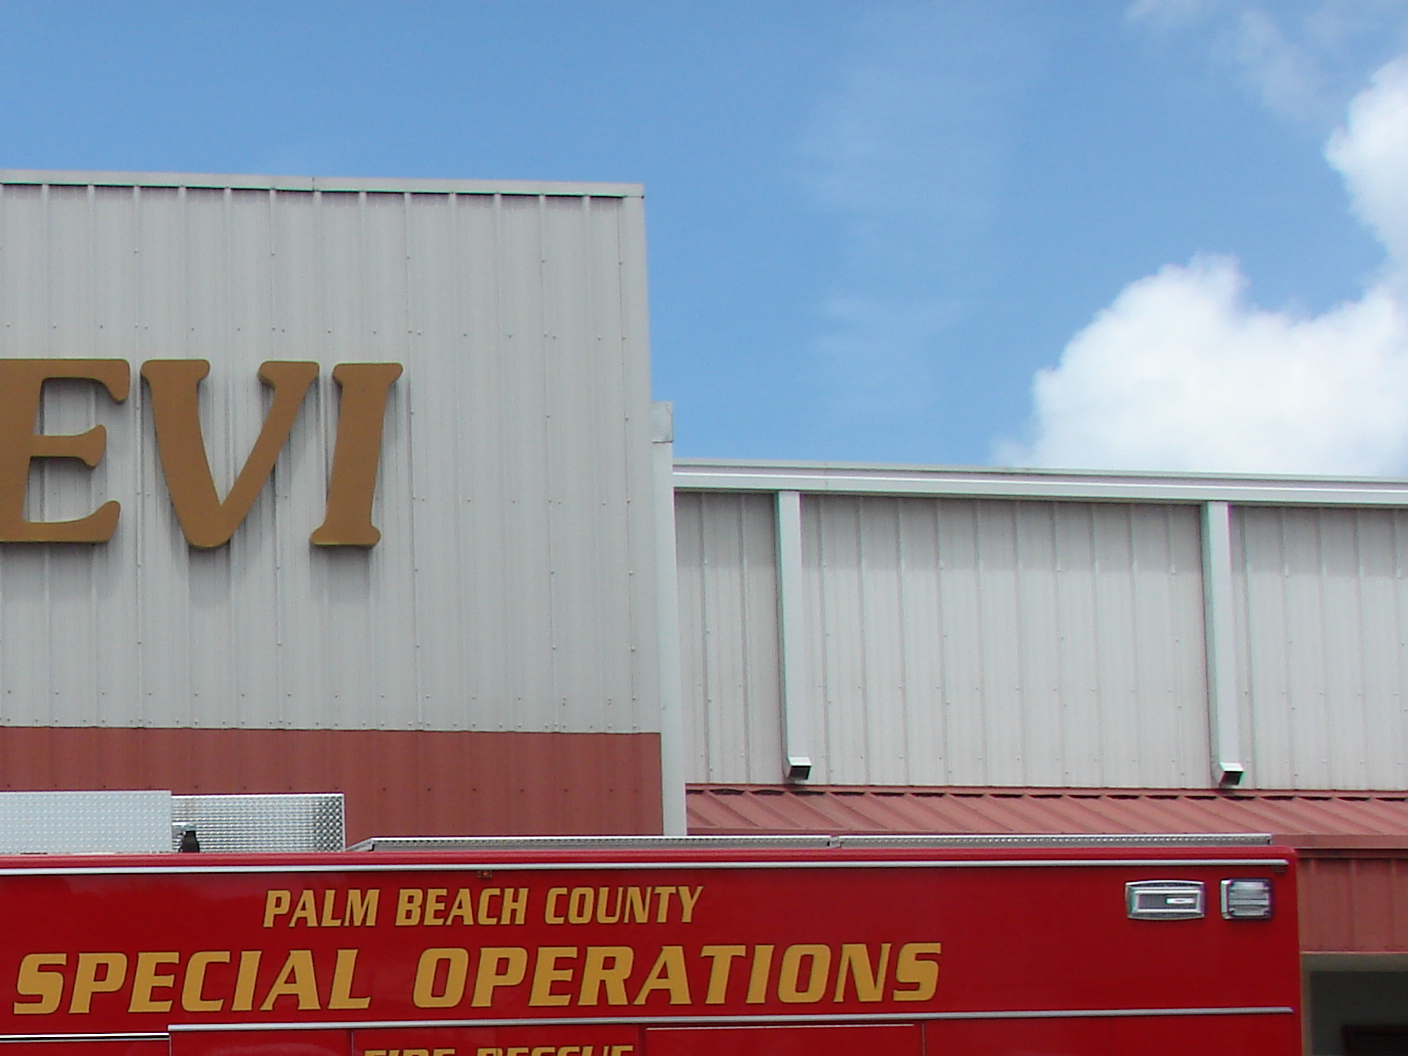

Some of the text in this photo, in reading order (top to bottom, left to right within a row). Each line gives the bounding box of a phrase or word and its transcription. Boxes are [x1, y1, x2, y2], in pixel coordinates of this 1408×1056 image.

[263, 885, 704, 928] PALM BEACH COUNTY
[13, 942, 941, 1015] SPECIAL OPERATIONS
